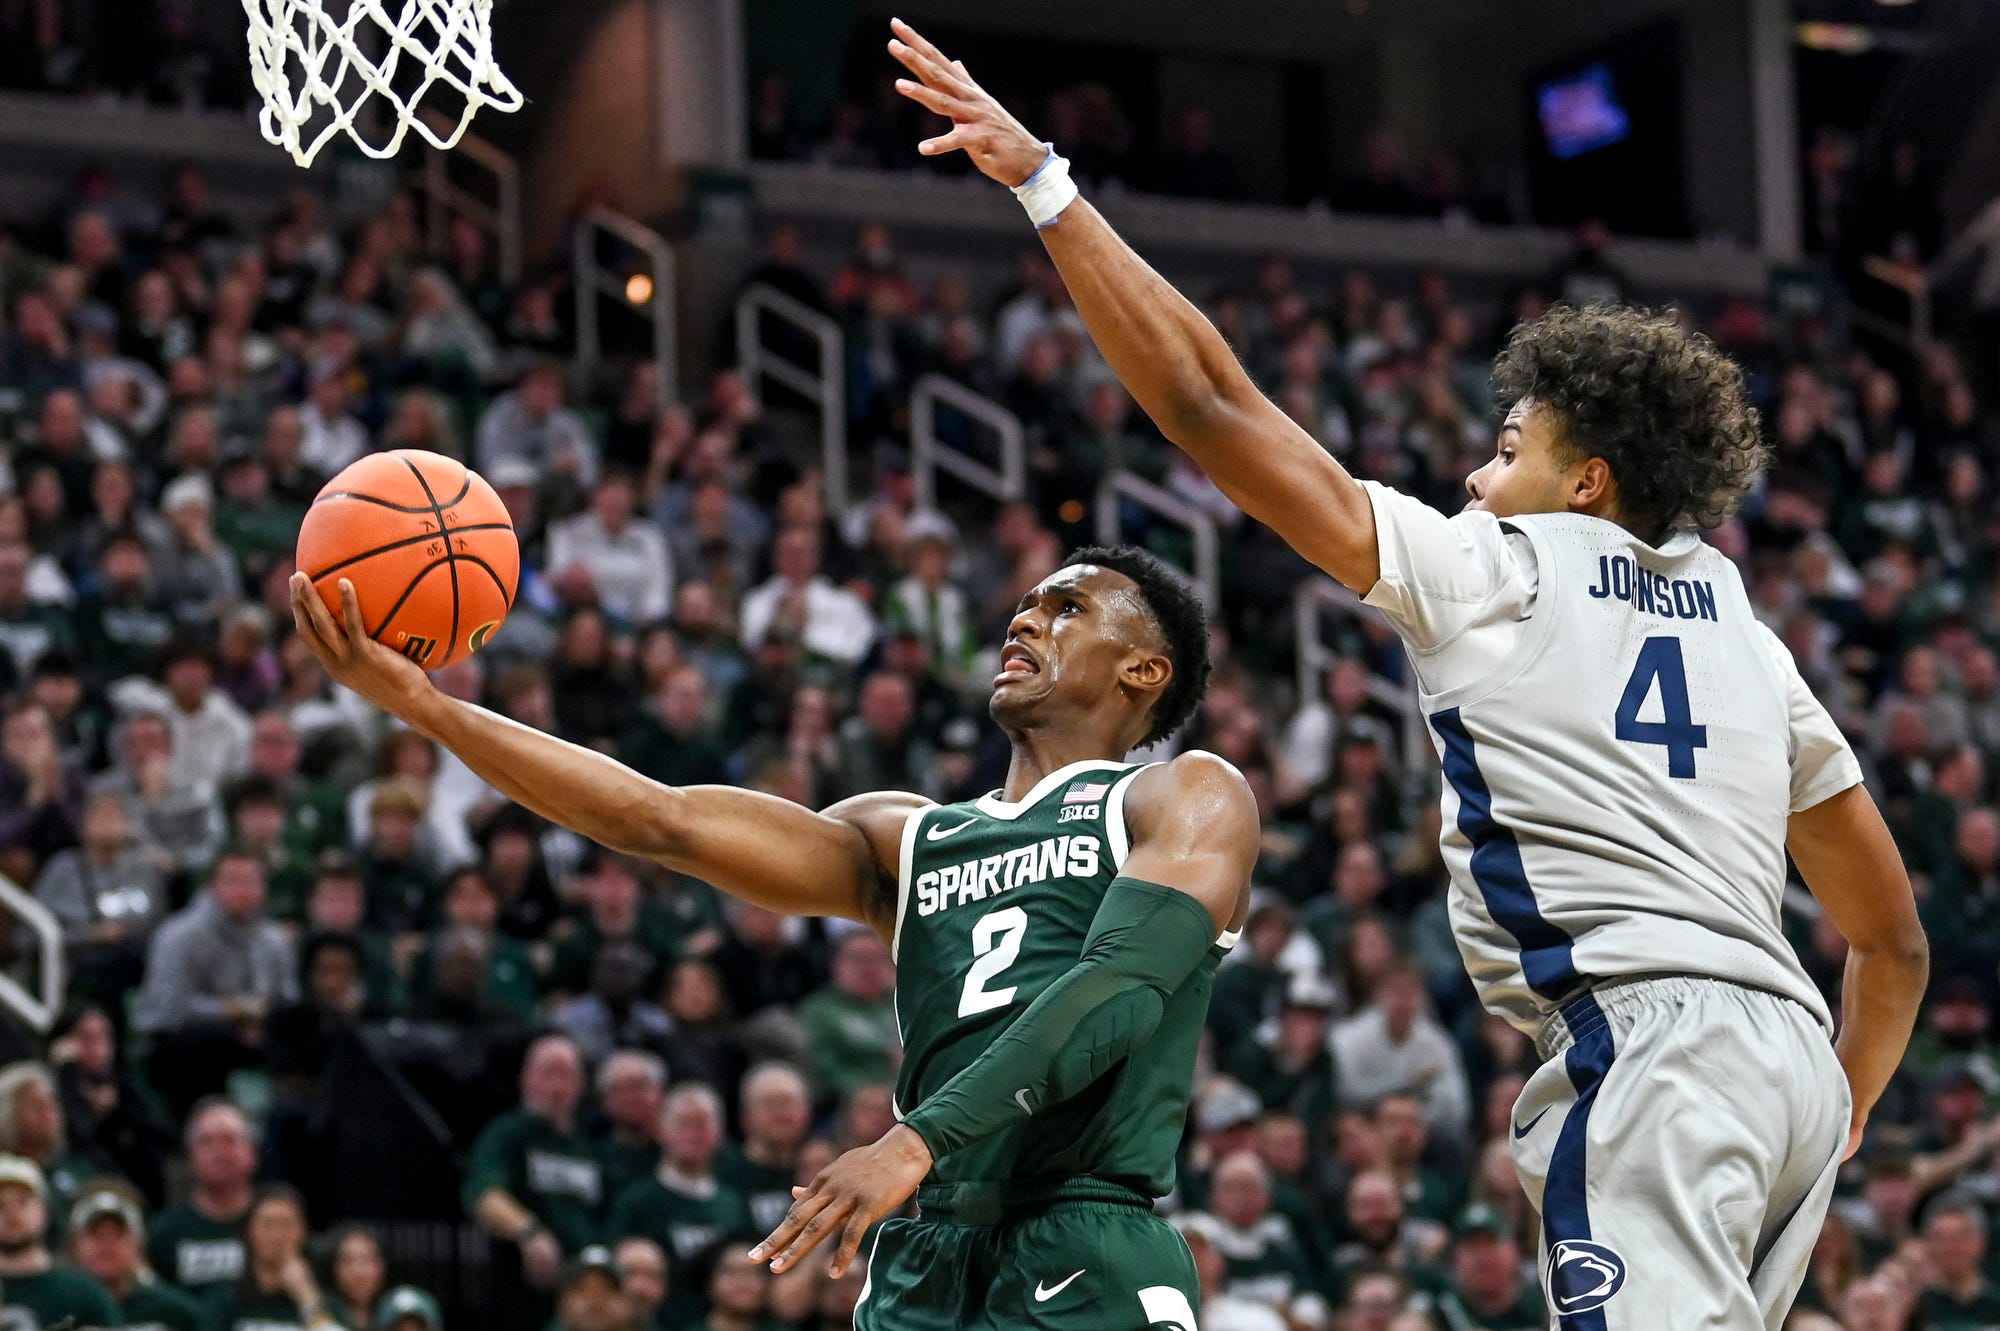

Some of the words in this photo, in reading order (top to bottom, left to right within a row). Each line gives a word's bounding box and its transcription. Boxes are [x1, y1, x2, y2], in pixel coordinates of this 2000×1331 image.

[1589, 555, 1718, 622] JOHNSON
[1615, 636, 1707, 779] 4
[916, 835, 1100, 917] SPARTANS
[957, 906, 1028, 1019] 2
